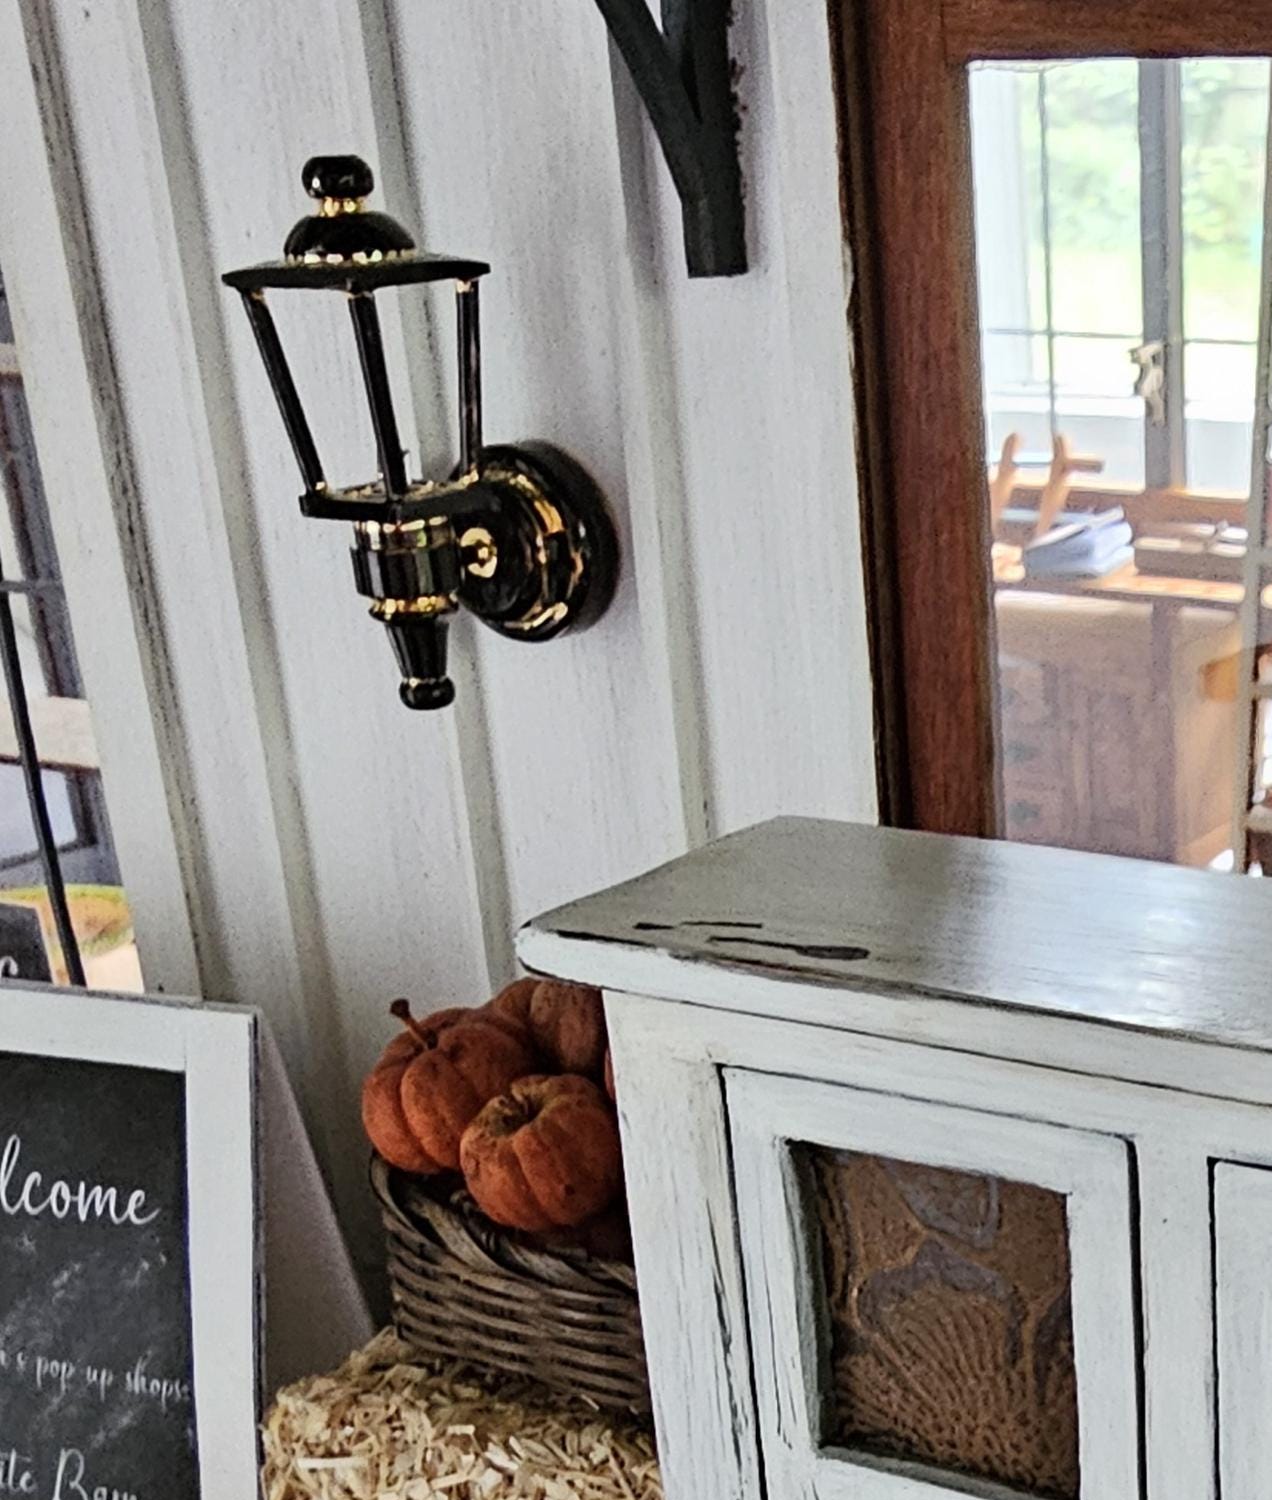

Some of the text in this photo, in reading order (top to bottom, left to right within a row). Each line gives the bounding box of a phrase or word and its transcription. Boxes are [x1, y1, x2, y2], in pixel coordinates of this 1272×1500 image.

[1, 1134, 160, 1225] lcome
[36, 1355, 76, 1393] pop
[86, 1365, 114, 1402] up
